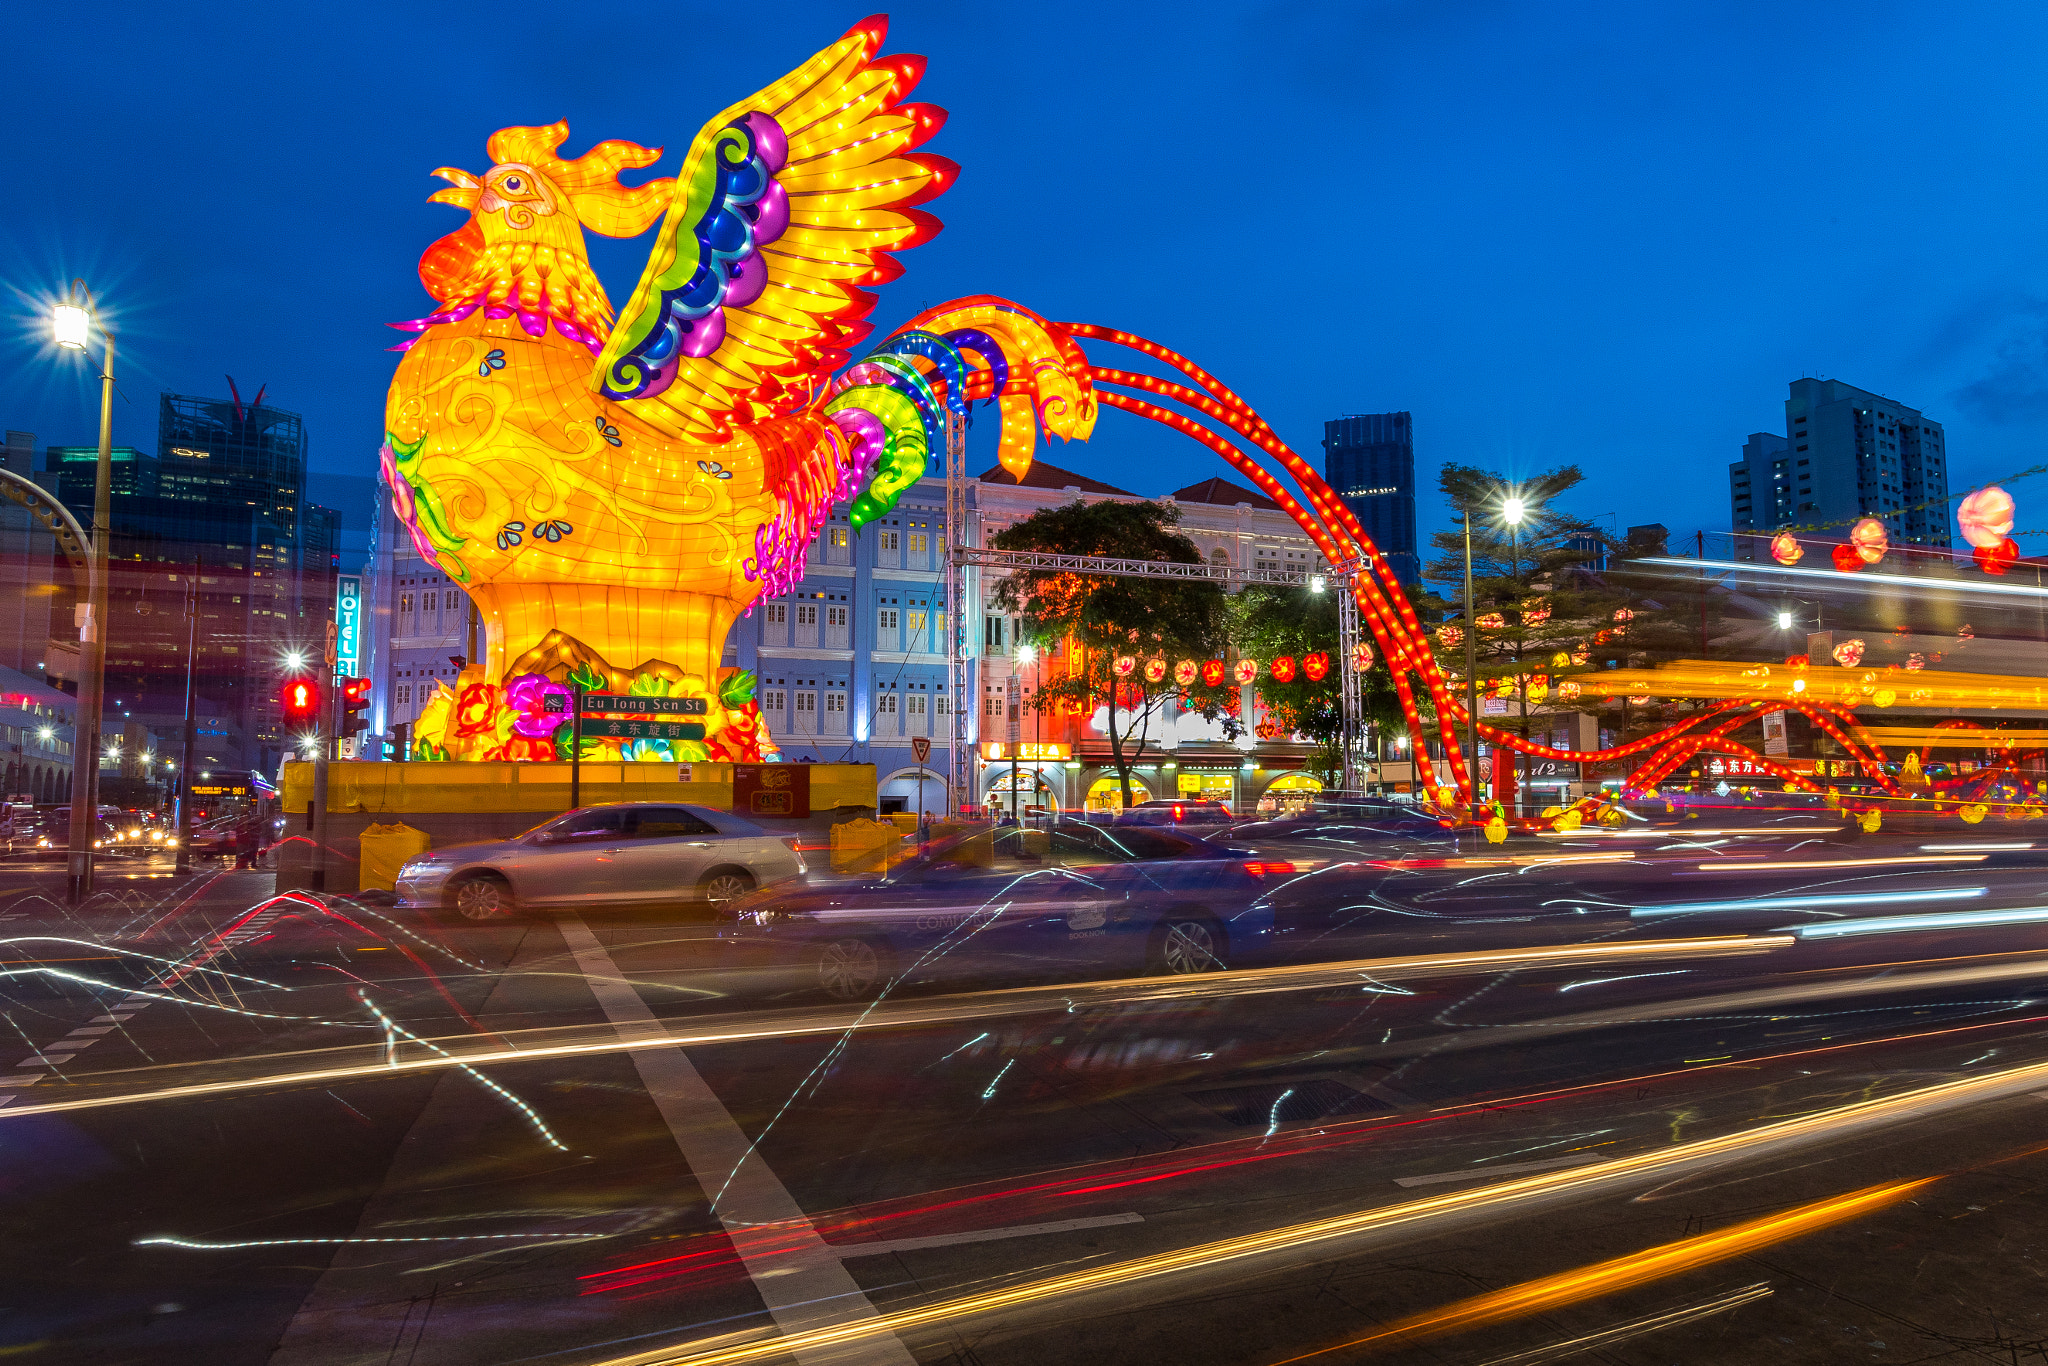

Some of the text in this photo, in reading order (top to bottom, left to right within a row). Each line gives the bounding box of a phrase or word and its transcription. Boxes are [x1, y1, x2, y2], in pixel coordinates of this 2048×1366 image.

[341, 582, 356, 654] HOTEL
[587, 697, 700, 712] Eu Tong Sen St
[608, 721, 681, 737] 余东旋街
[1547, 762, 1556, 775] 2
[1068, 929, 1106, 940] BOOK NOW
